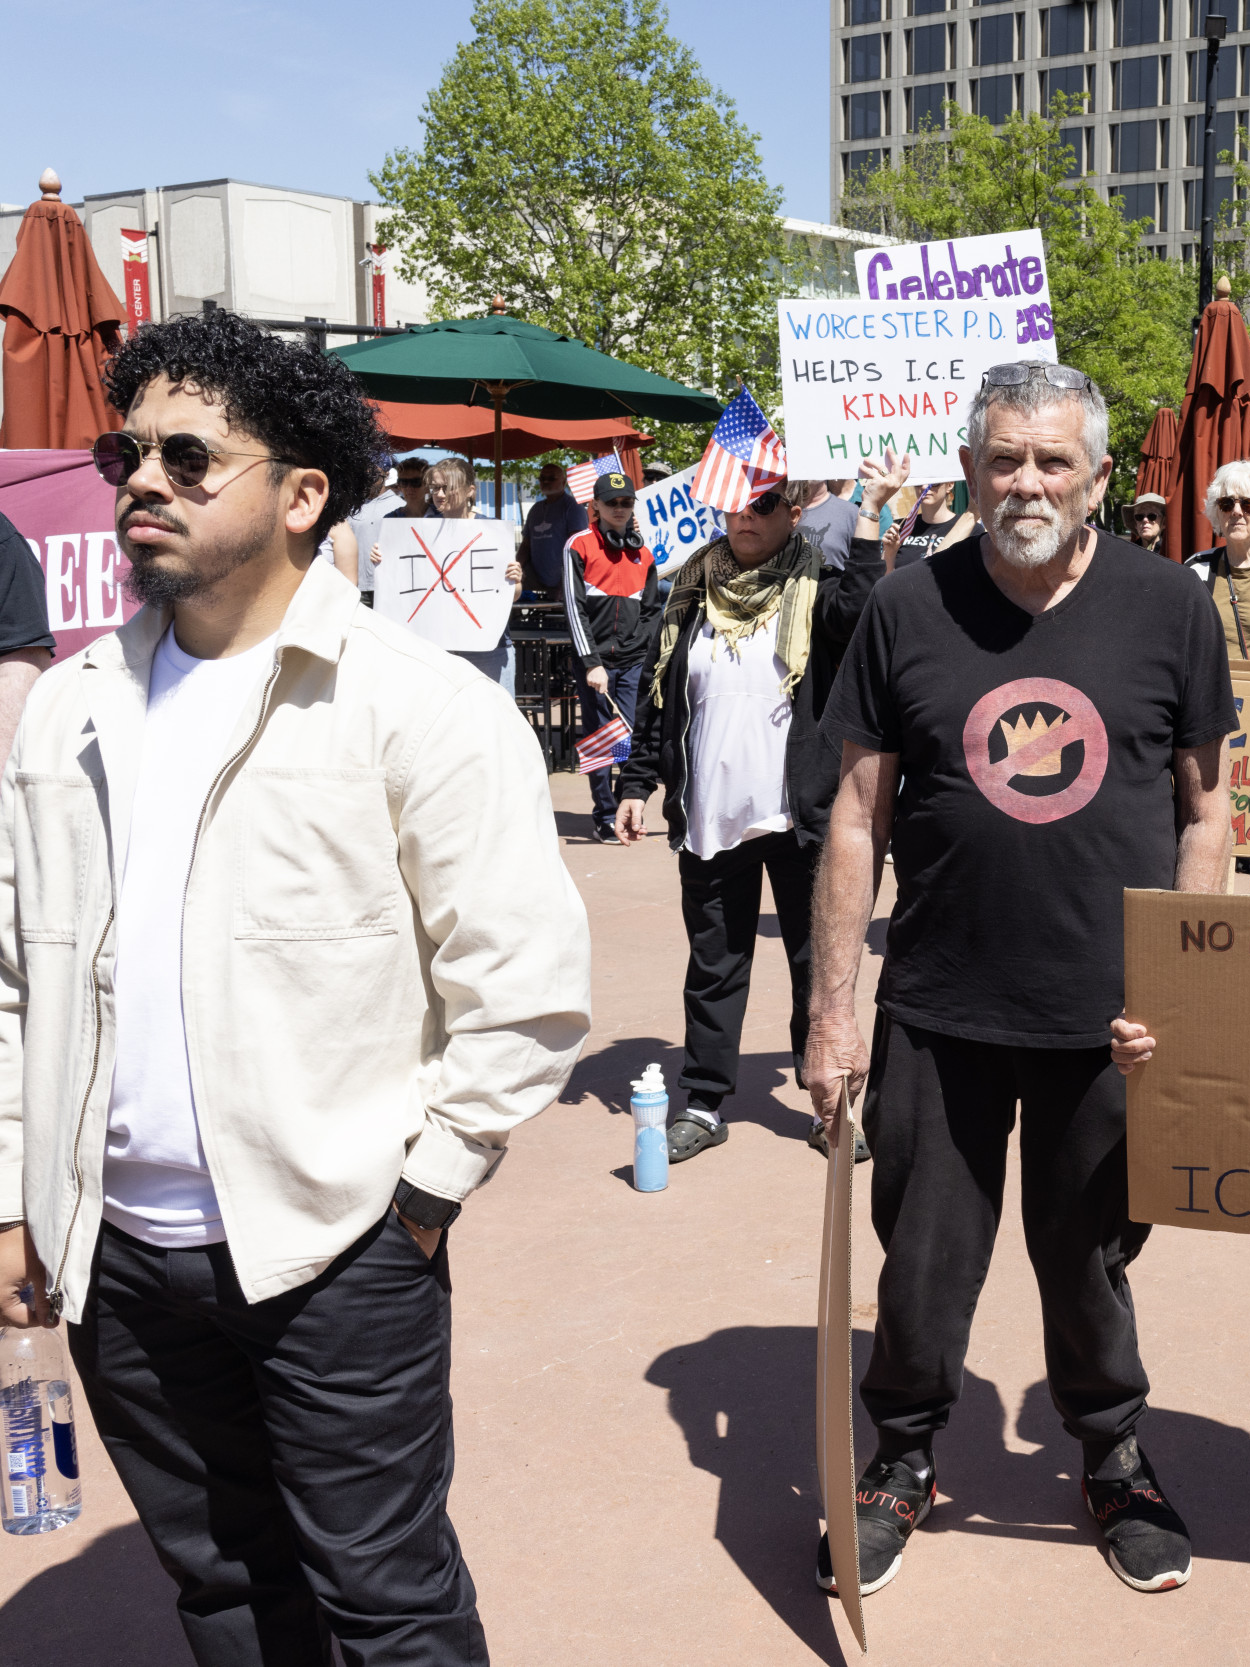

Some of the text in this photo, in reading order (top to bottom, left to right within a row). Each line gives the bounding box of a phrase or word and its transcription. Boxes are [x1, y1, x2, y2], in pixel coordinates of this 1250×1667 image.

[867, 242, 1044, 300] Celebrate
[134, 279, 143, 318] CENTER
[787, 310, 953, 340] WORCESTER
[792, 359, 882, 383] HELPS
[843, 391, 958, 421] KIDNAP
[826, 426, 968, 459] HUMANS
[26, 531, 123, 631] EE
[399, 548, 499, 595] I.C.E.
[1180, 920, 1235, 953] NO
[854, 1491, 916, 1525] AUTICA
